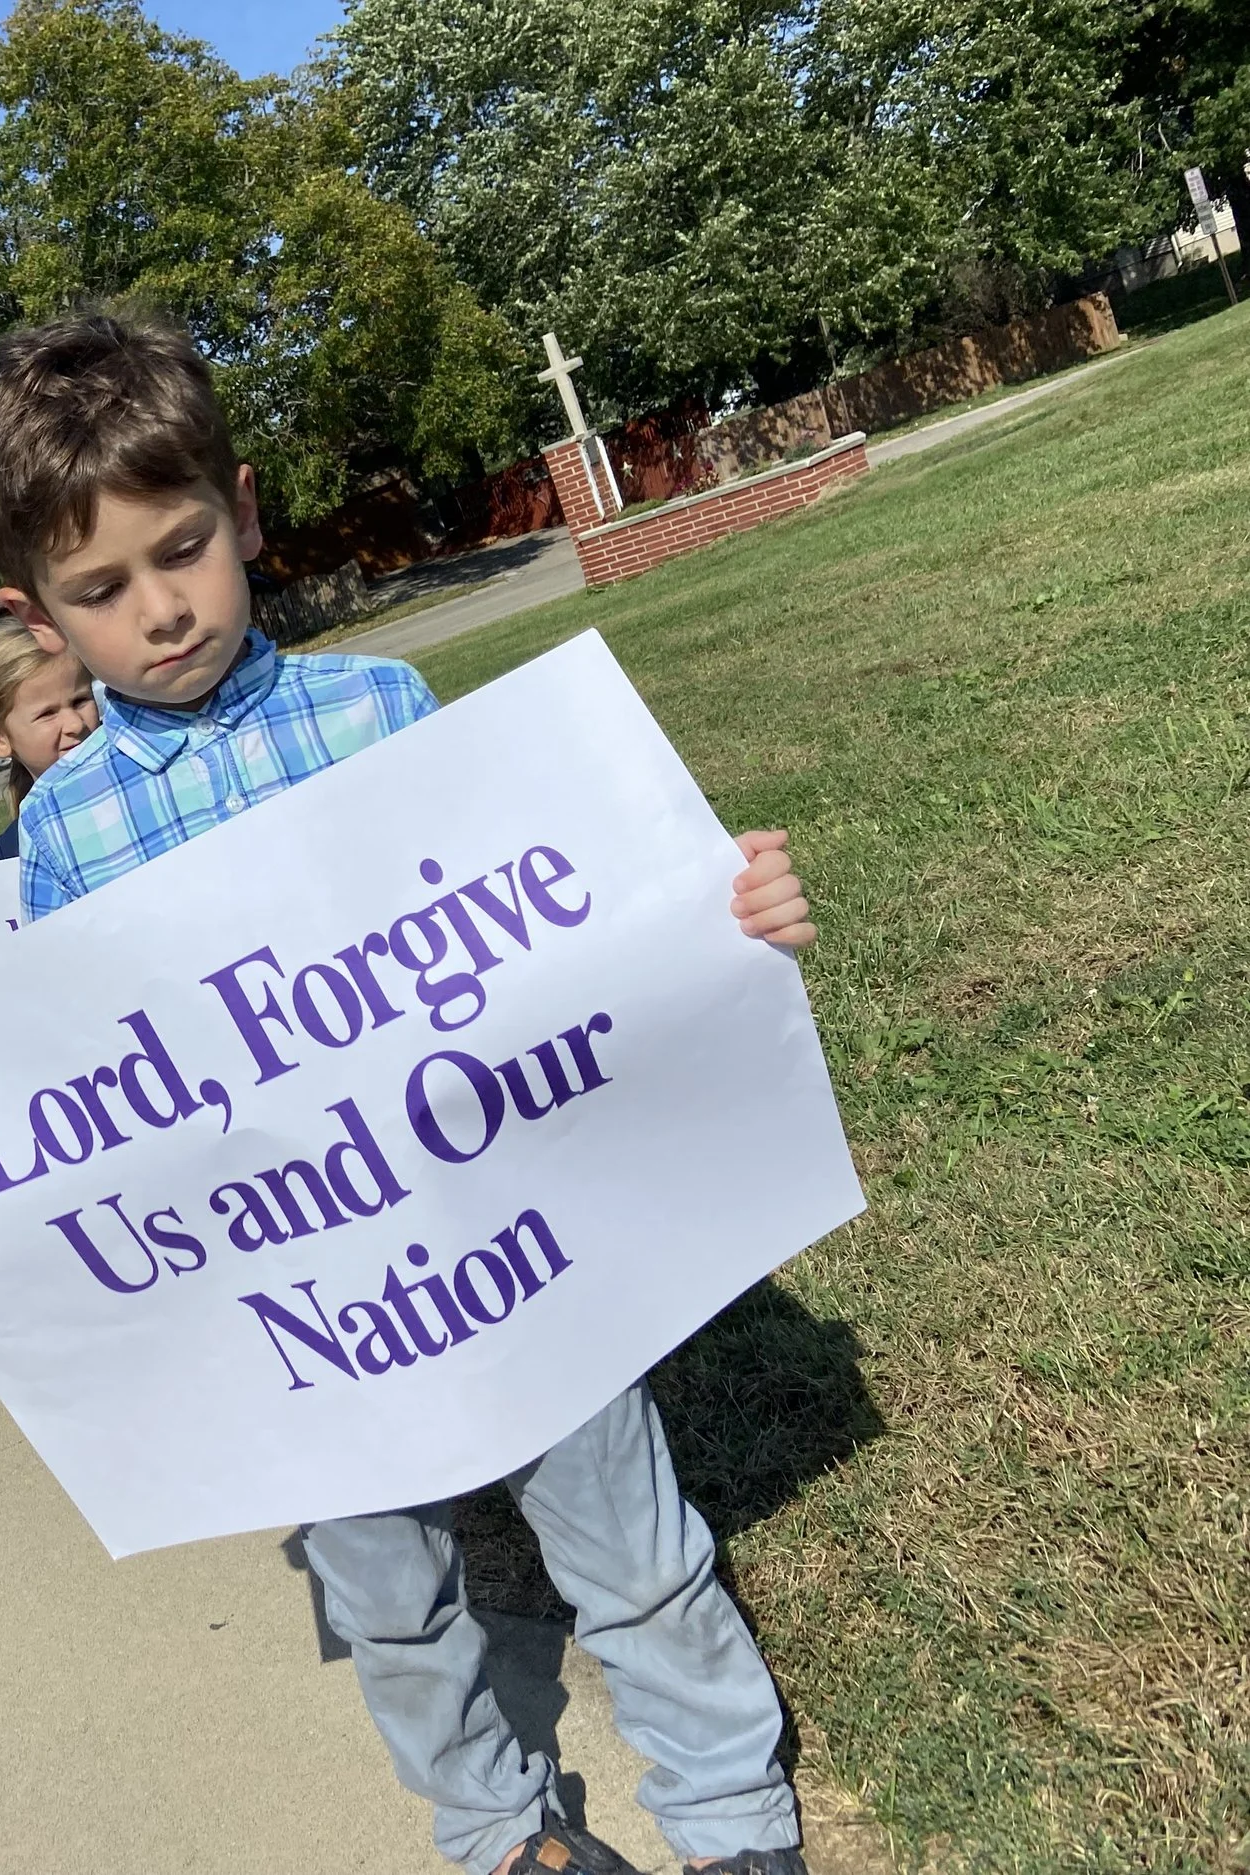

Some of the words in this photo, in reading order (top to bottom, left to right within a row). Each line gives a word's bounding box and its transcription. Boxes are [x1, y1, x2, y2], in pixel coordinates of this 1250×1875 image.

[199, 845, 592, 1086] Forgive
[47, 1193, 208, 1295] Us
[208, 1097, 412, 1254] and
[405, 1012, 613, 1165] Our
[237, 1208, 573, 1391] Nation
